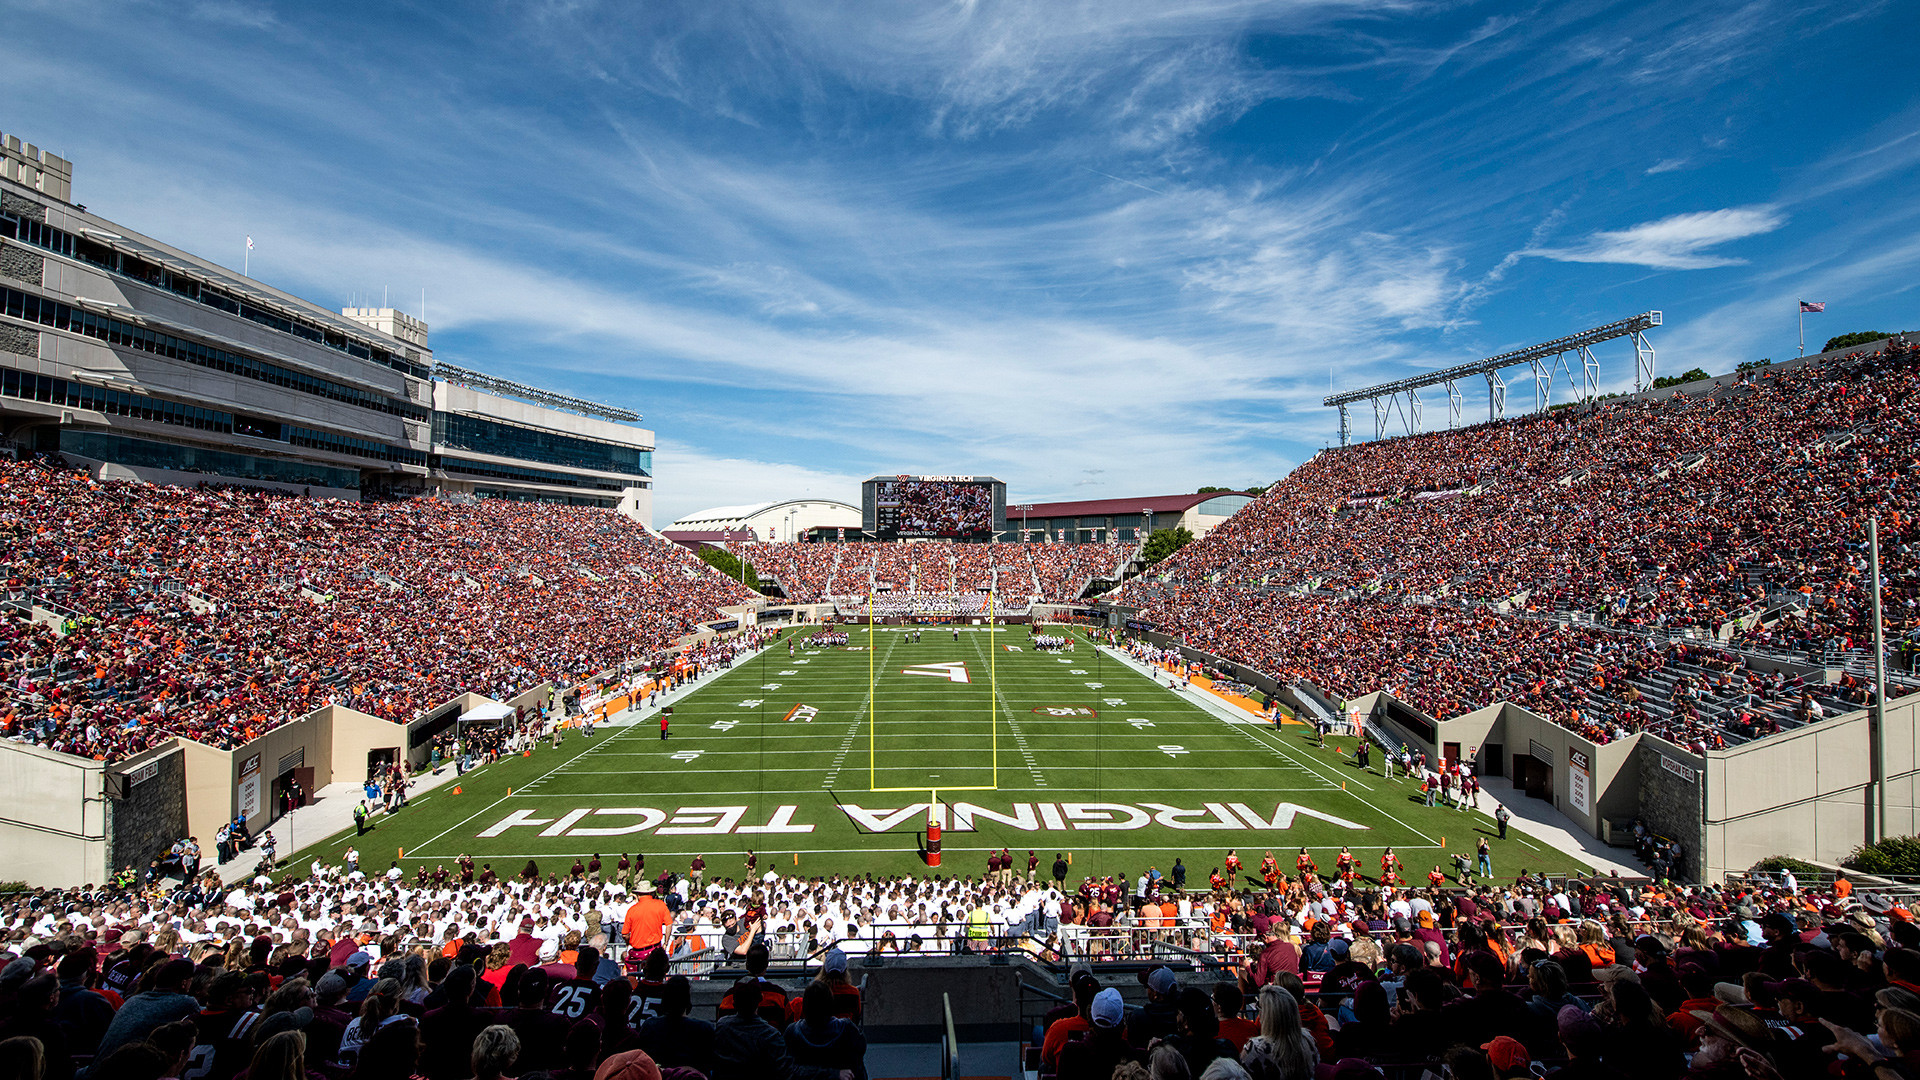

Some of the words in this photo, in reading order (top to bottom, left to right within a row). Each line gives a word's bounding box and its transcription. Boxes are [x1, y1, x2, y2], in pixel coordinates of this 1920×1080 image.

[711, 622, 727, 630] VIRGINIA
[727, 620, 738, 628] TECH
[670, 749, 705, 760] 10
[1157, 745, 1190, 755] 10
[243, 754, 259, 773] ACC
[1571, 751, 1587, 767] ACC
[1681, 765, 1694, 781] FIELD
[475, 804, 816, 838] TECH
[836, 801, 1373, 831] VIRGINIA
[1089, 887, 1101, 898] 25
[551, 985, 592, 1018] 25
